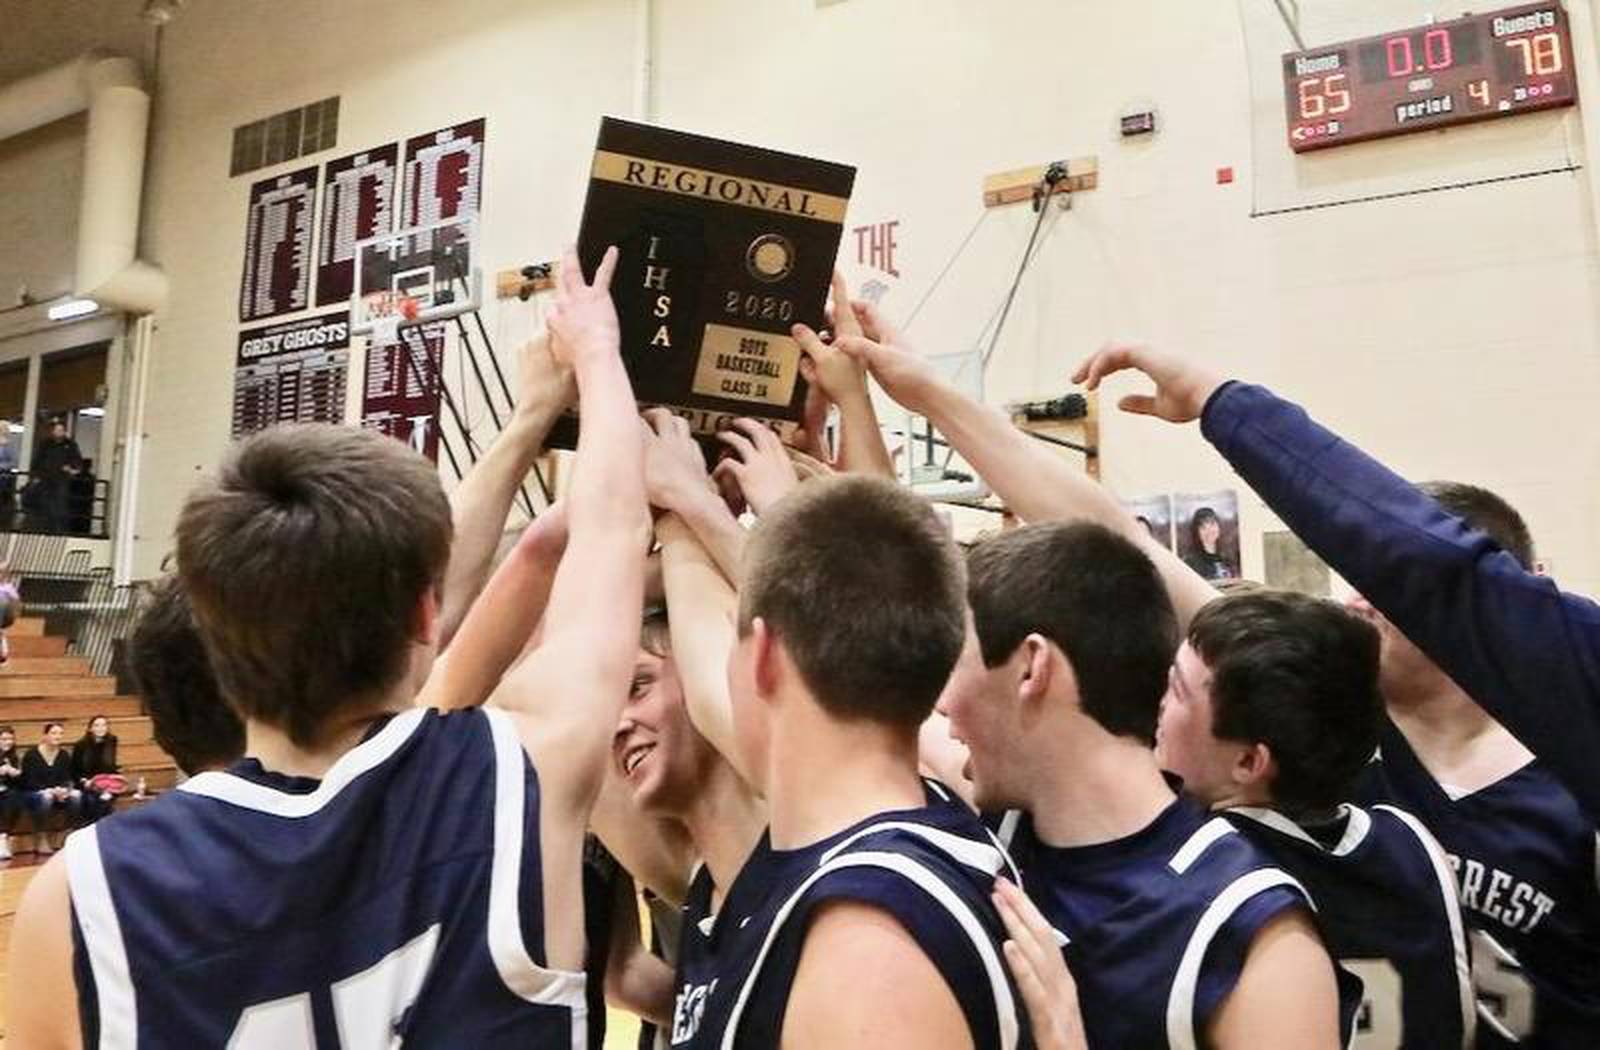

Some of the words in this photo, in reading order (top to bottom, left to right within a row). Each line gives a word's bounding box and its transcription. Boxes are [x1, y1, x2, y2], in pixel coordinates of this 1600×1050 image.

[1384, 29, 1452, 76] 0.0
[1505, 33, 1562, 75] 78
[1300, 74, 1350, 118] 65
[1469, 80, 1489, 106] 4
[624, 161, 817, 216] REGIONAL
[853, 220, 900, 279] THE
[724, 290, 793, 321] 2020
[241, 332, 284, 359] GREY
[283, 322, 348, 353] GHOSTS
[716, 353, 780, 379] BASKETBALL
[721, 379, 752, 395] CLASS
